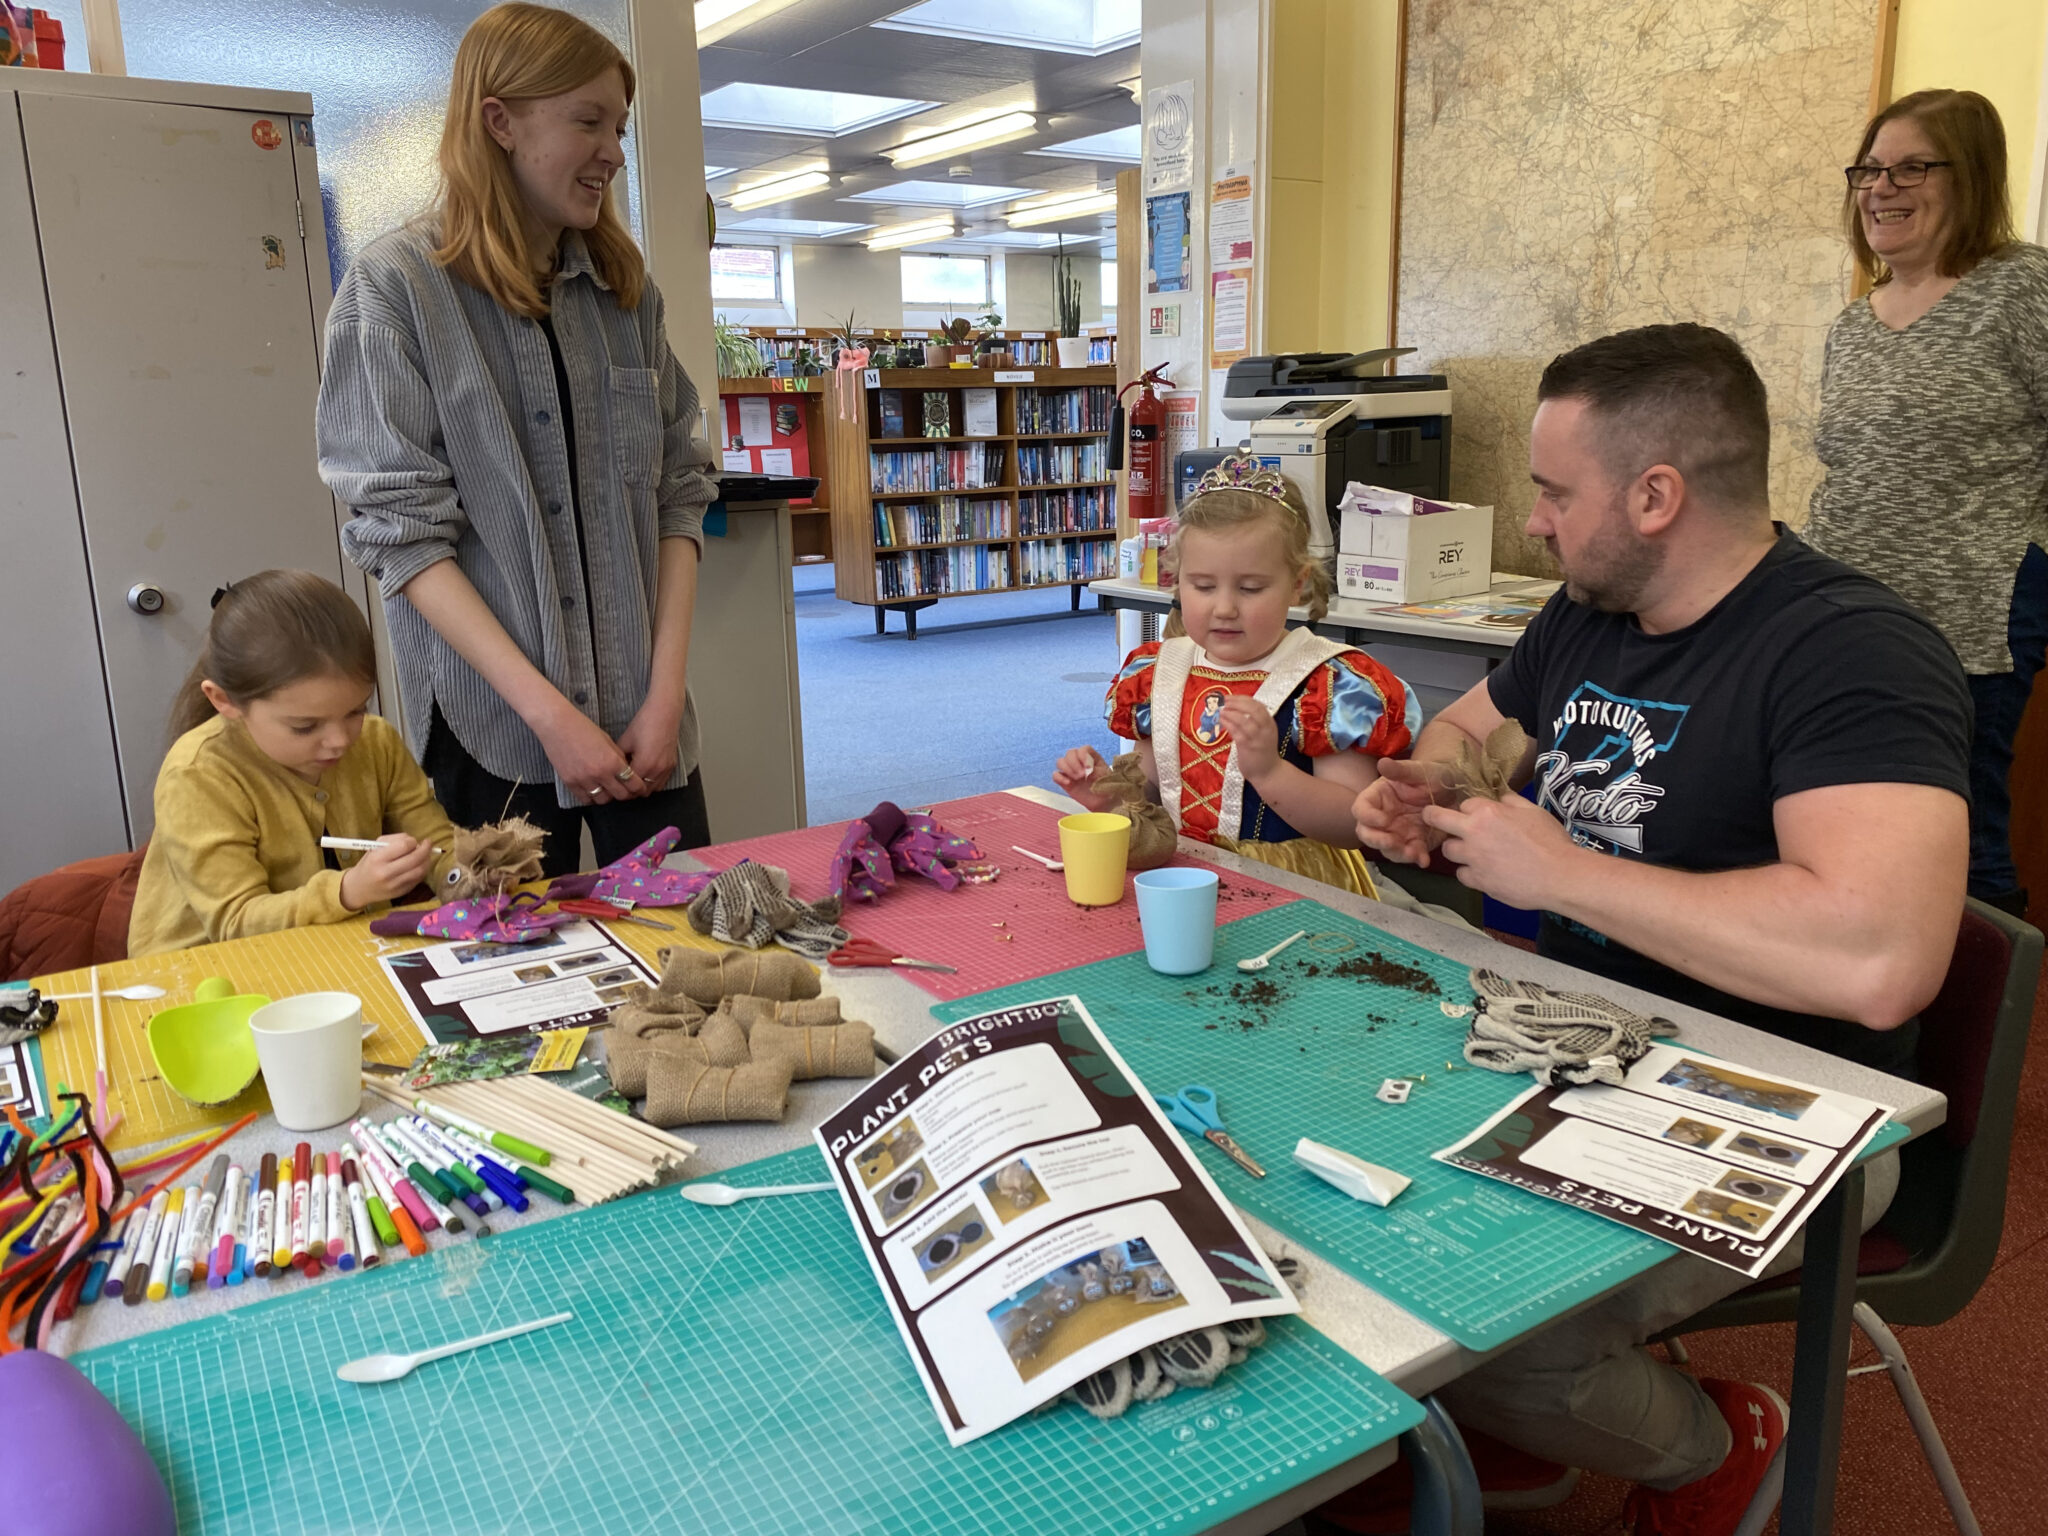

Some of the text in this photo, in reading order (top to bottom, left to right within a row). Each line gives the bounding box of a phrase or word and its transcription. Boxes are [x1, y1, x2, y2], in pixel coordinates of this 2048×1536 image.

[771, 377, 809, 392] NEW
[867, 374, 878, 384] M
[1439, 549, 1463, 565] REY
[1344, 567, 1361, 577] REY
[1364, 581, 1375, 590] 80
[1535, 750, 1665, 833] Kyoto
[938, 1001, 1075, 1048] BRIGHTBOX
[830, 1083, 911, 1158] PLANT
[918, 1036, 992, 1087] PETS
[1558, 1180, 1765, 1258] PLANT PETS
